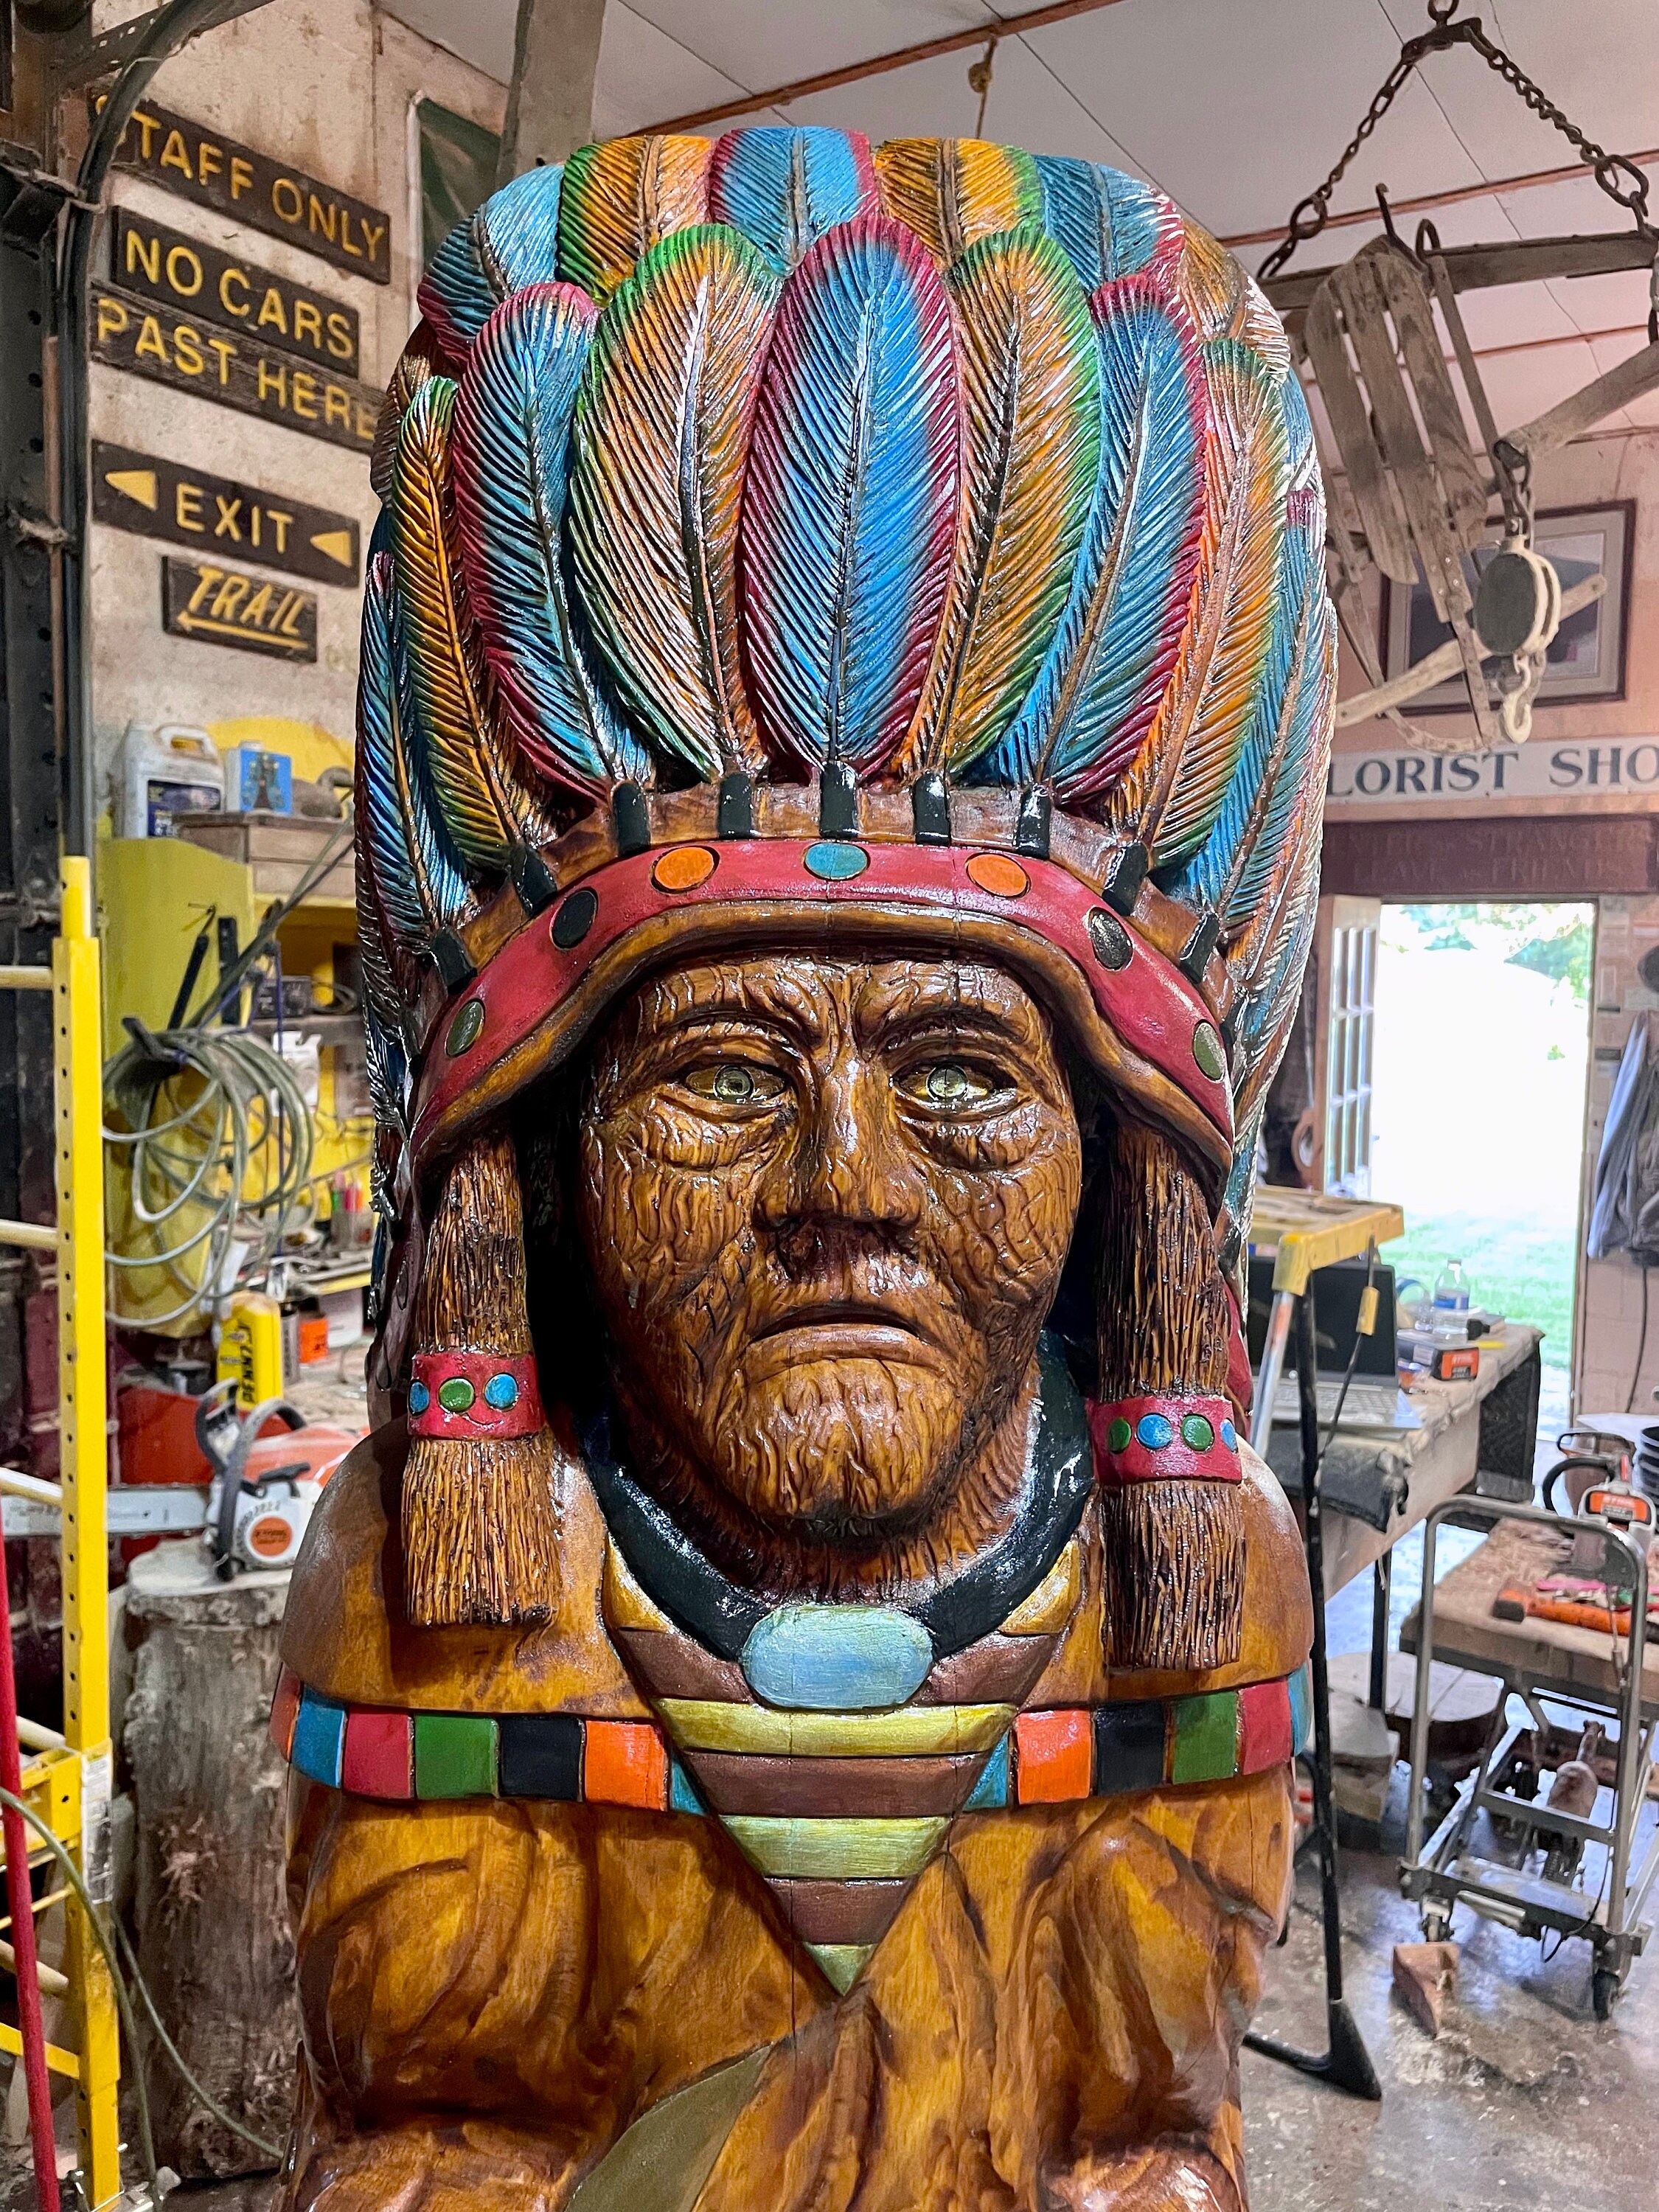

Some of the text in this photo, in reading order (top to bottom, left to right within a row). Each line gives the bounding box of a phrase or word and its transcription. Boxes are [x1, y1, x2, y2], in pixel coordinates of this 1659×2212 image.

[272, 178, 384, 261] ONLY
[126, 229, 354, 359] NO CARS
[97, 298, 376, 440] PAST HERE
[176, 481, 293, 554] EXIT
[187, 566, 306, 636] TRAIL
[1548, 744, 1659, 788] SHO
